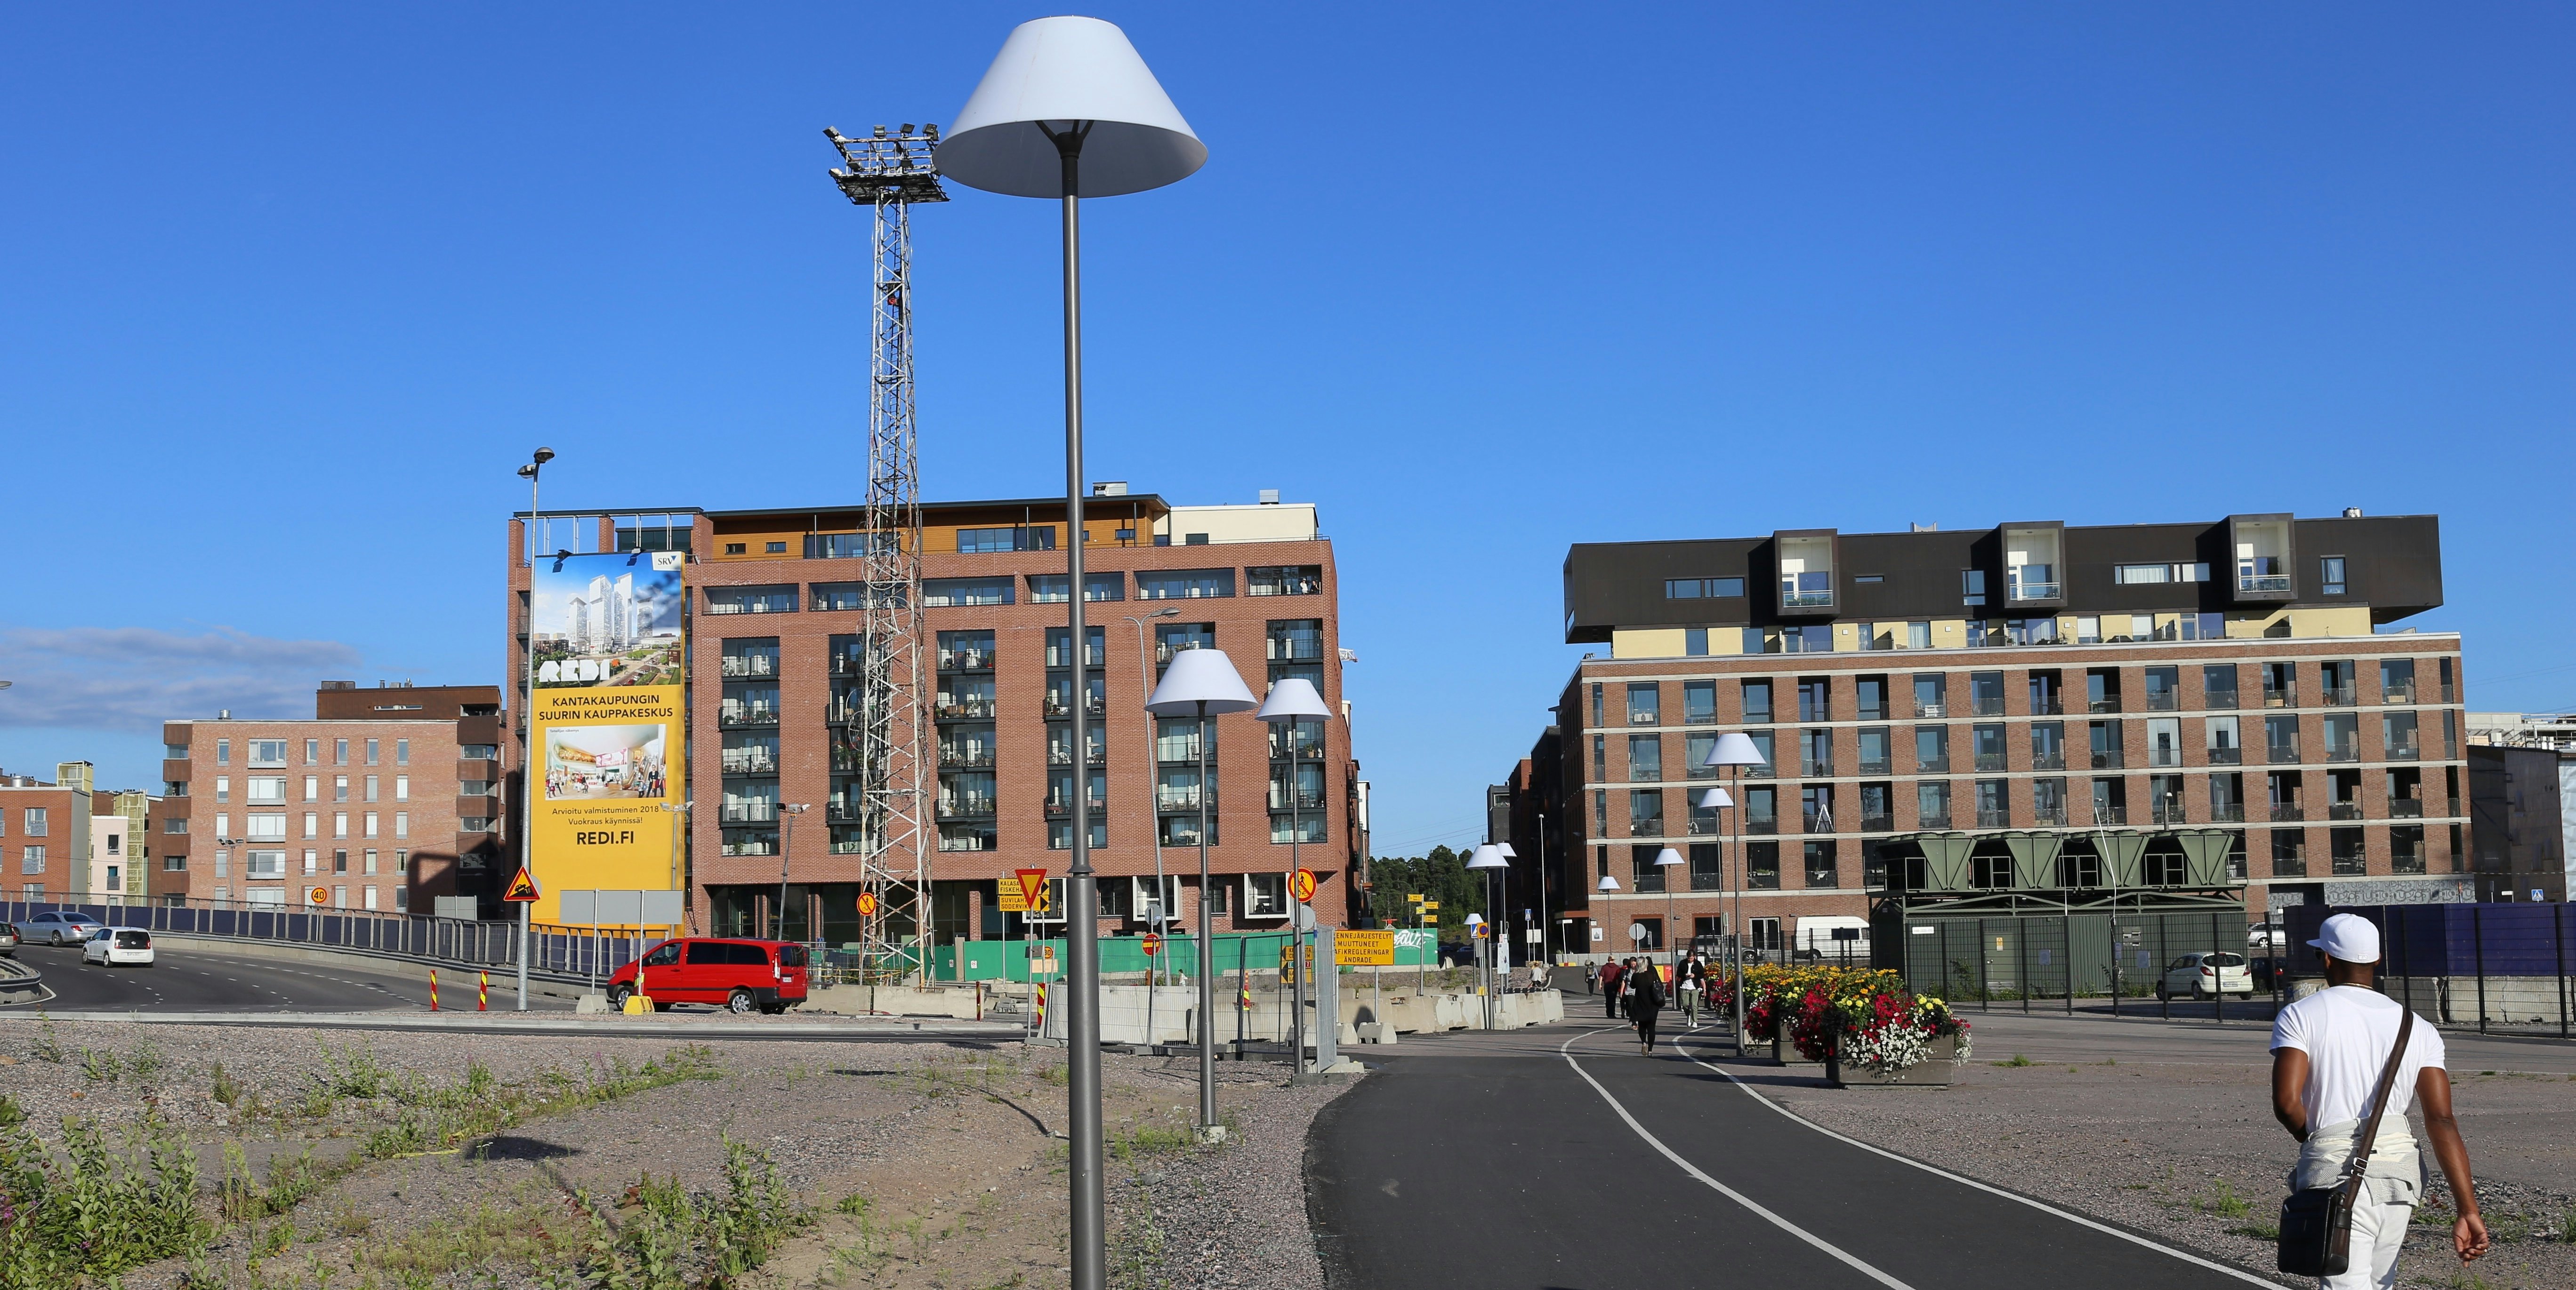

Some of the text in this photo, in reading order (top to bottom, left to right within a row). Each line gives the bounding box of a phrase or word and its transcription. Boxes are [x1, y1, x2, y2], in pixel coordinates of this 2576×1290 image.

[539, 660, 610, 682] REDI
[553, 695, 659, 706] KANTAKAUPUNGIN
[539, 708, 673, 721] SUURIN KAUPPAKESKUS
[552, 806, 581, 815] Arvioitu
[584, 806, 638, 814] valmistuminen
[605, 817, 643, 826] käynnissä!
[577, 831, 634, 845] REDI.FI
[314, 891, 324, 899] 40
